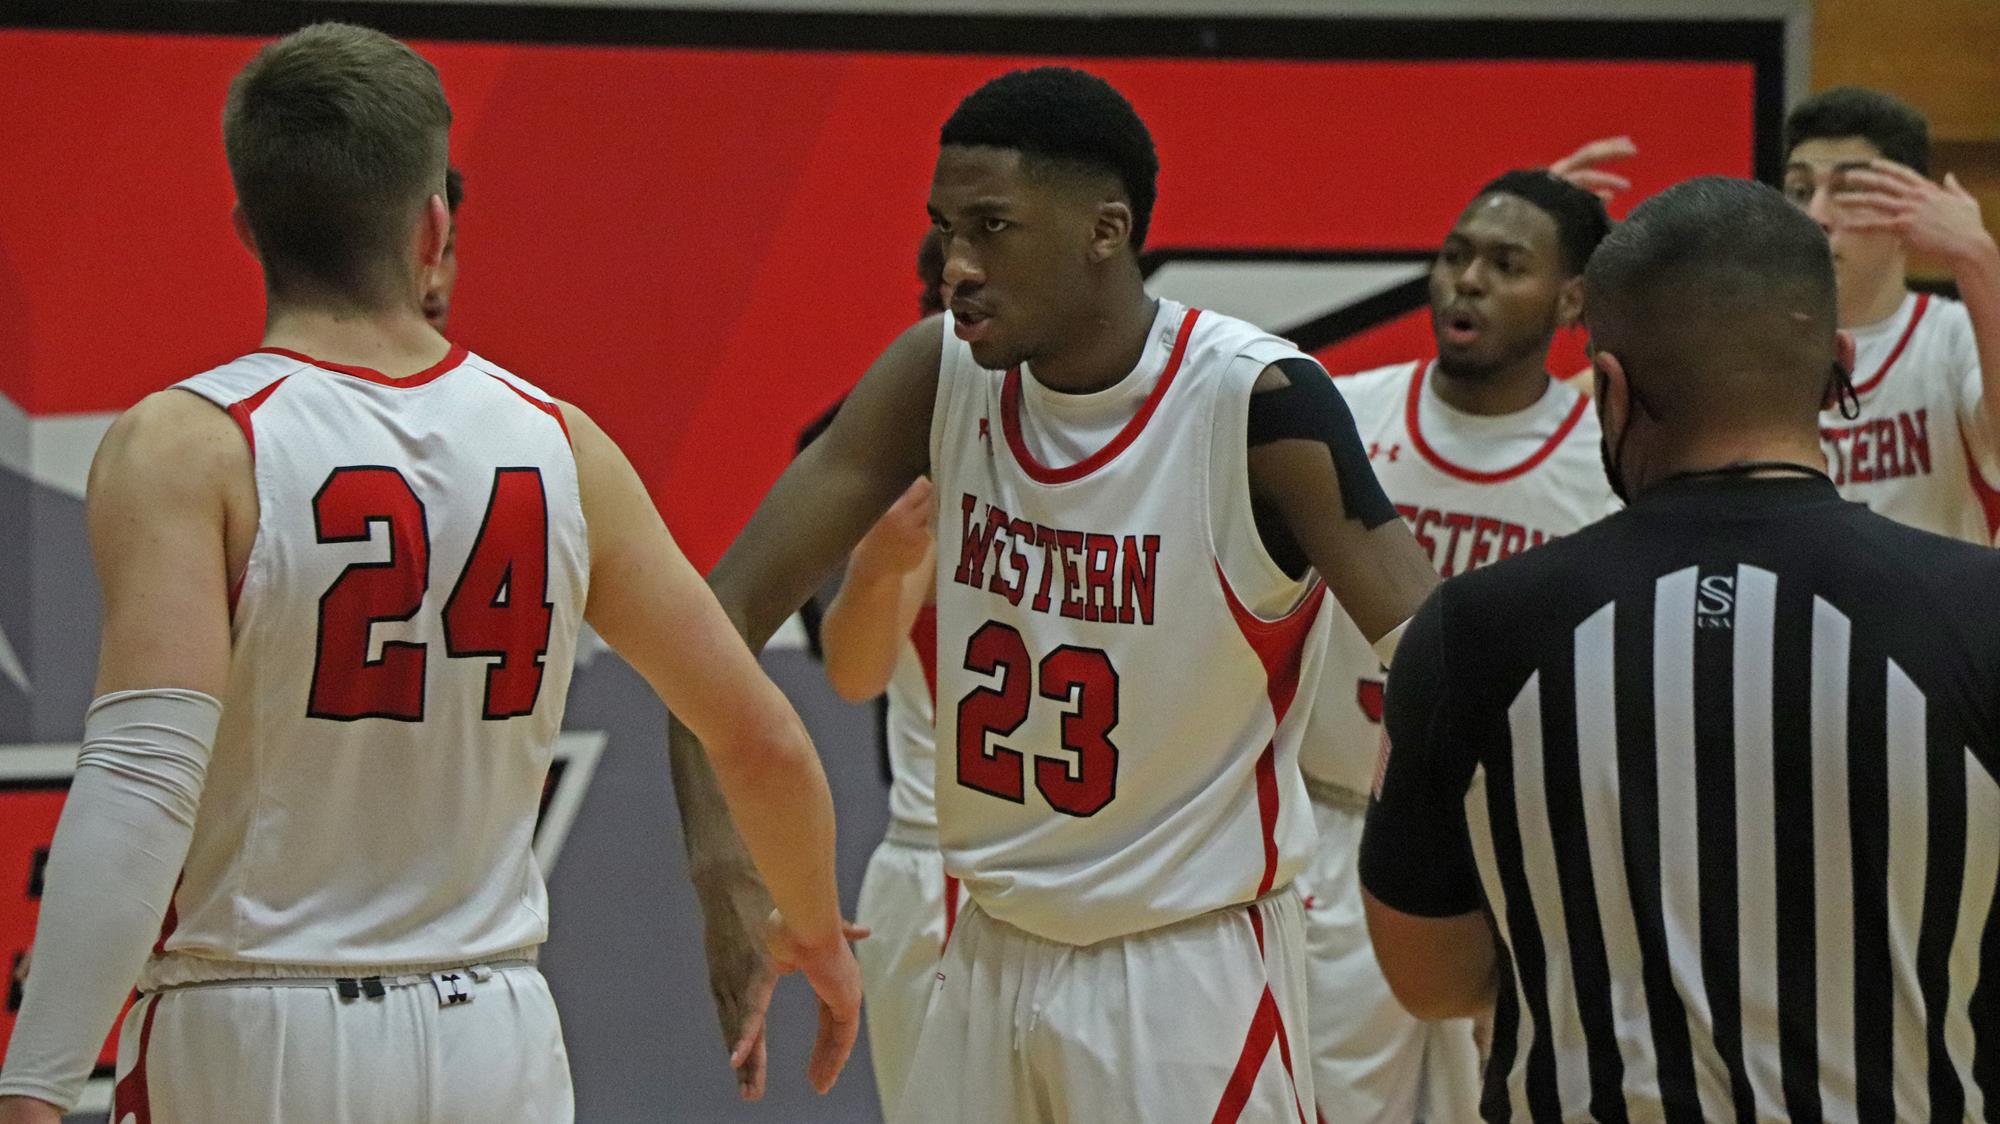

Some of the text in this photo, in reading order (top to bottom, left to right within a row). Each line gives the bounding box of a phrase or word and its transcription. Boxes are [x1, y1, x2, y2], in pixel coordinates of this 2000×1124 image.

[306, 464, 554, 723] 24
[954, 493, 1160, 626] WESTERN
[1394, 503, 1558, 579] STER
[956, 619, 1120, 818] 23
